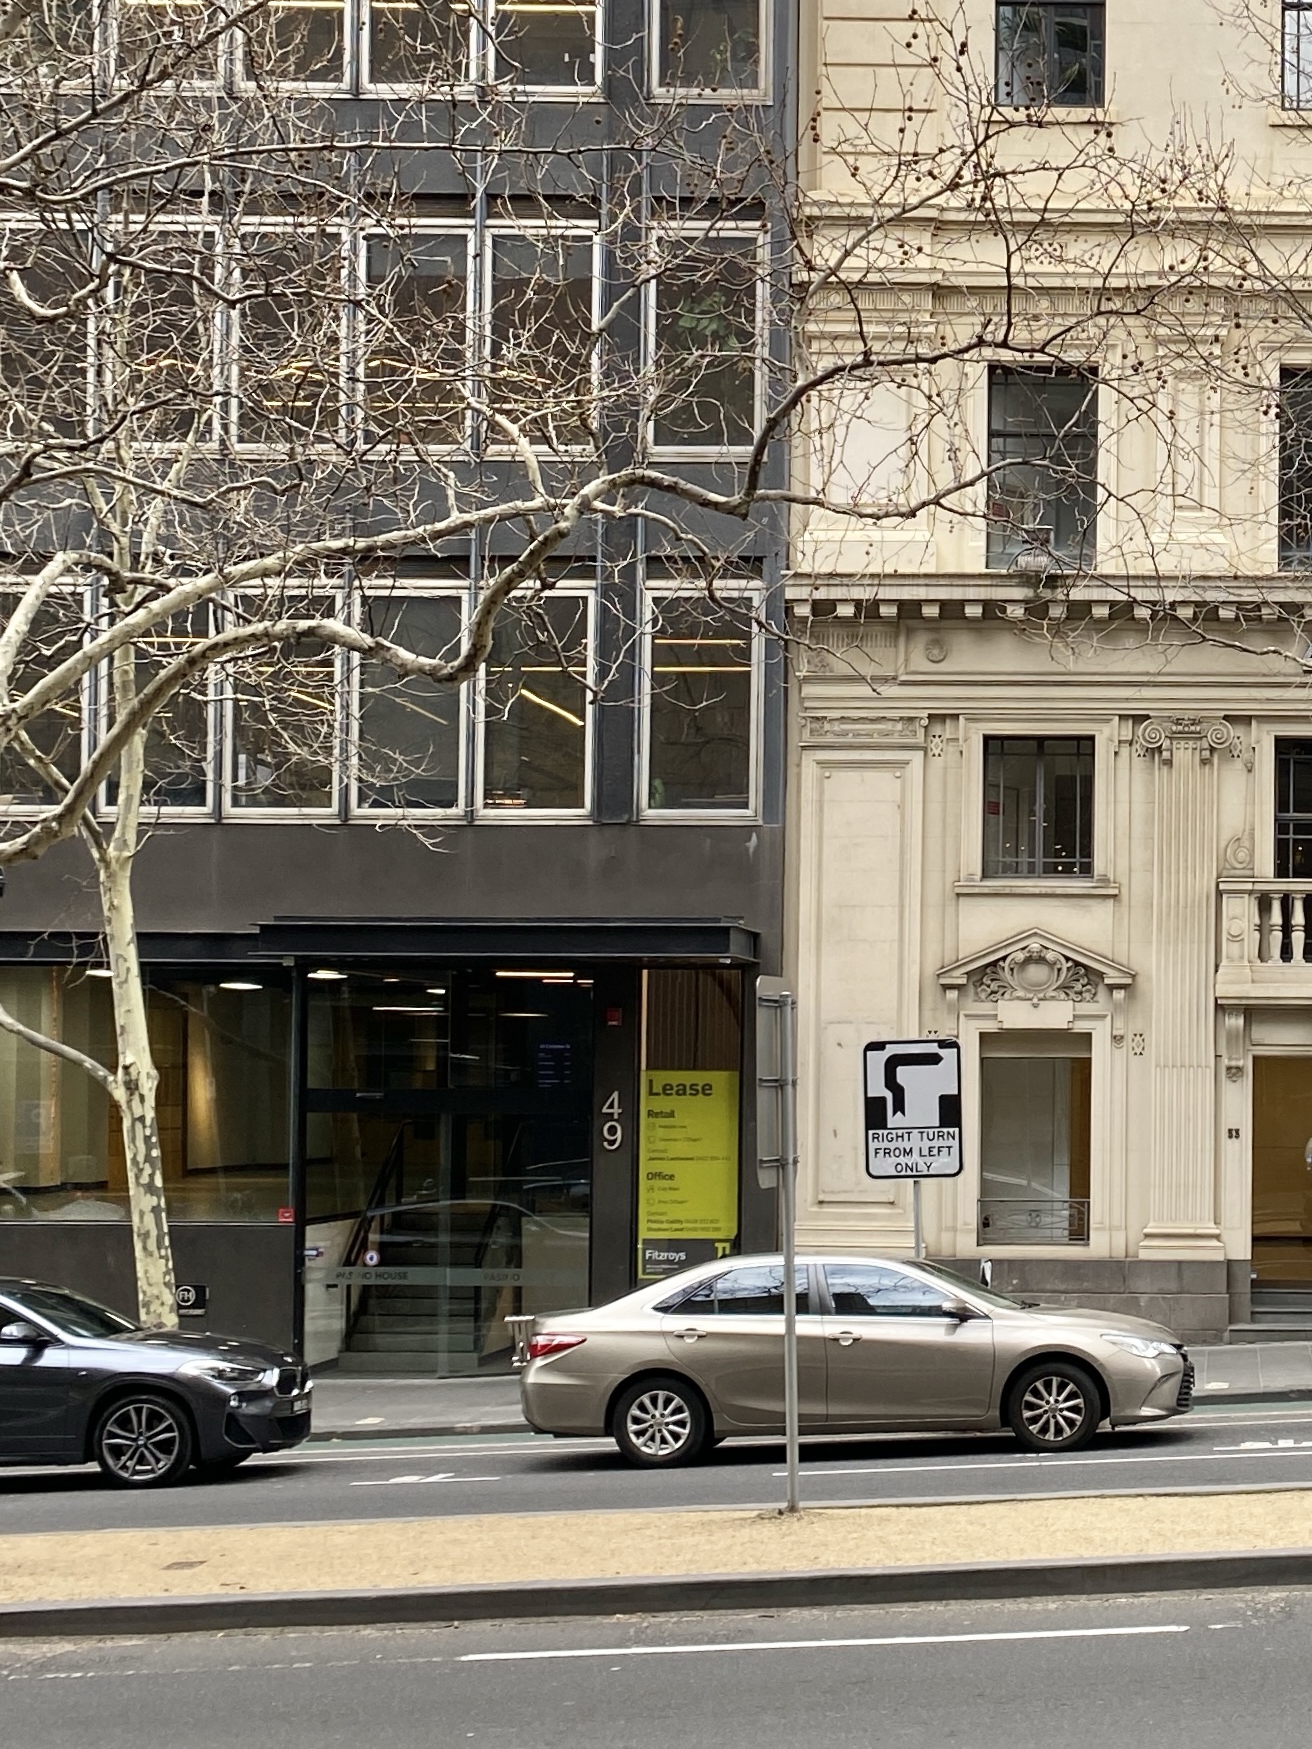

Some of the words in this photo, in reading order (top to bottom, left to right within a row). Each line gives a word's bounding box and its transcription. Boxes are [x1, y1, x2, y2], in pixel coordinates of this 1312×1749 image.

[648, 1078, 713, 1097] Lease
[647, 1109, 676, 1119] Retail
[871, 1131, 913, 1143] RIGHT
[918, 1130, 956, 1142] TURN
[874, 1146, 913, 1158] FROM
[919, 1145, 953, 1157] LEFT
[894, 1162, 933, 1173] ONLY
[646, 1172, 675, 1181] Office
[645, 1249, 686, 1262] Fitzroys
[375, 1271, 409, 1280] HOUSE
